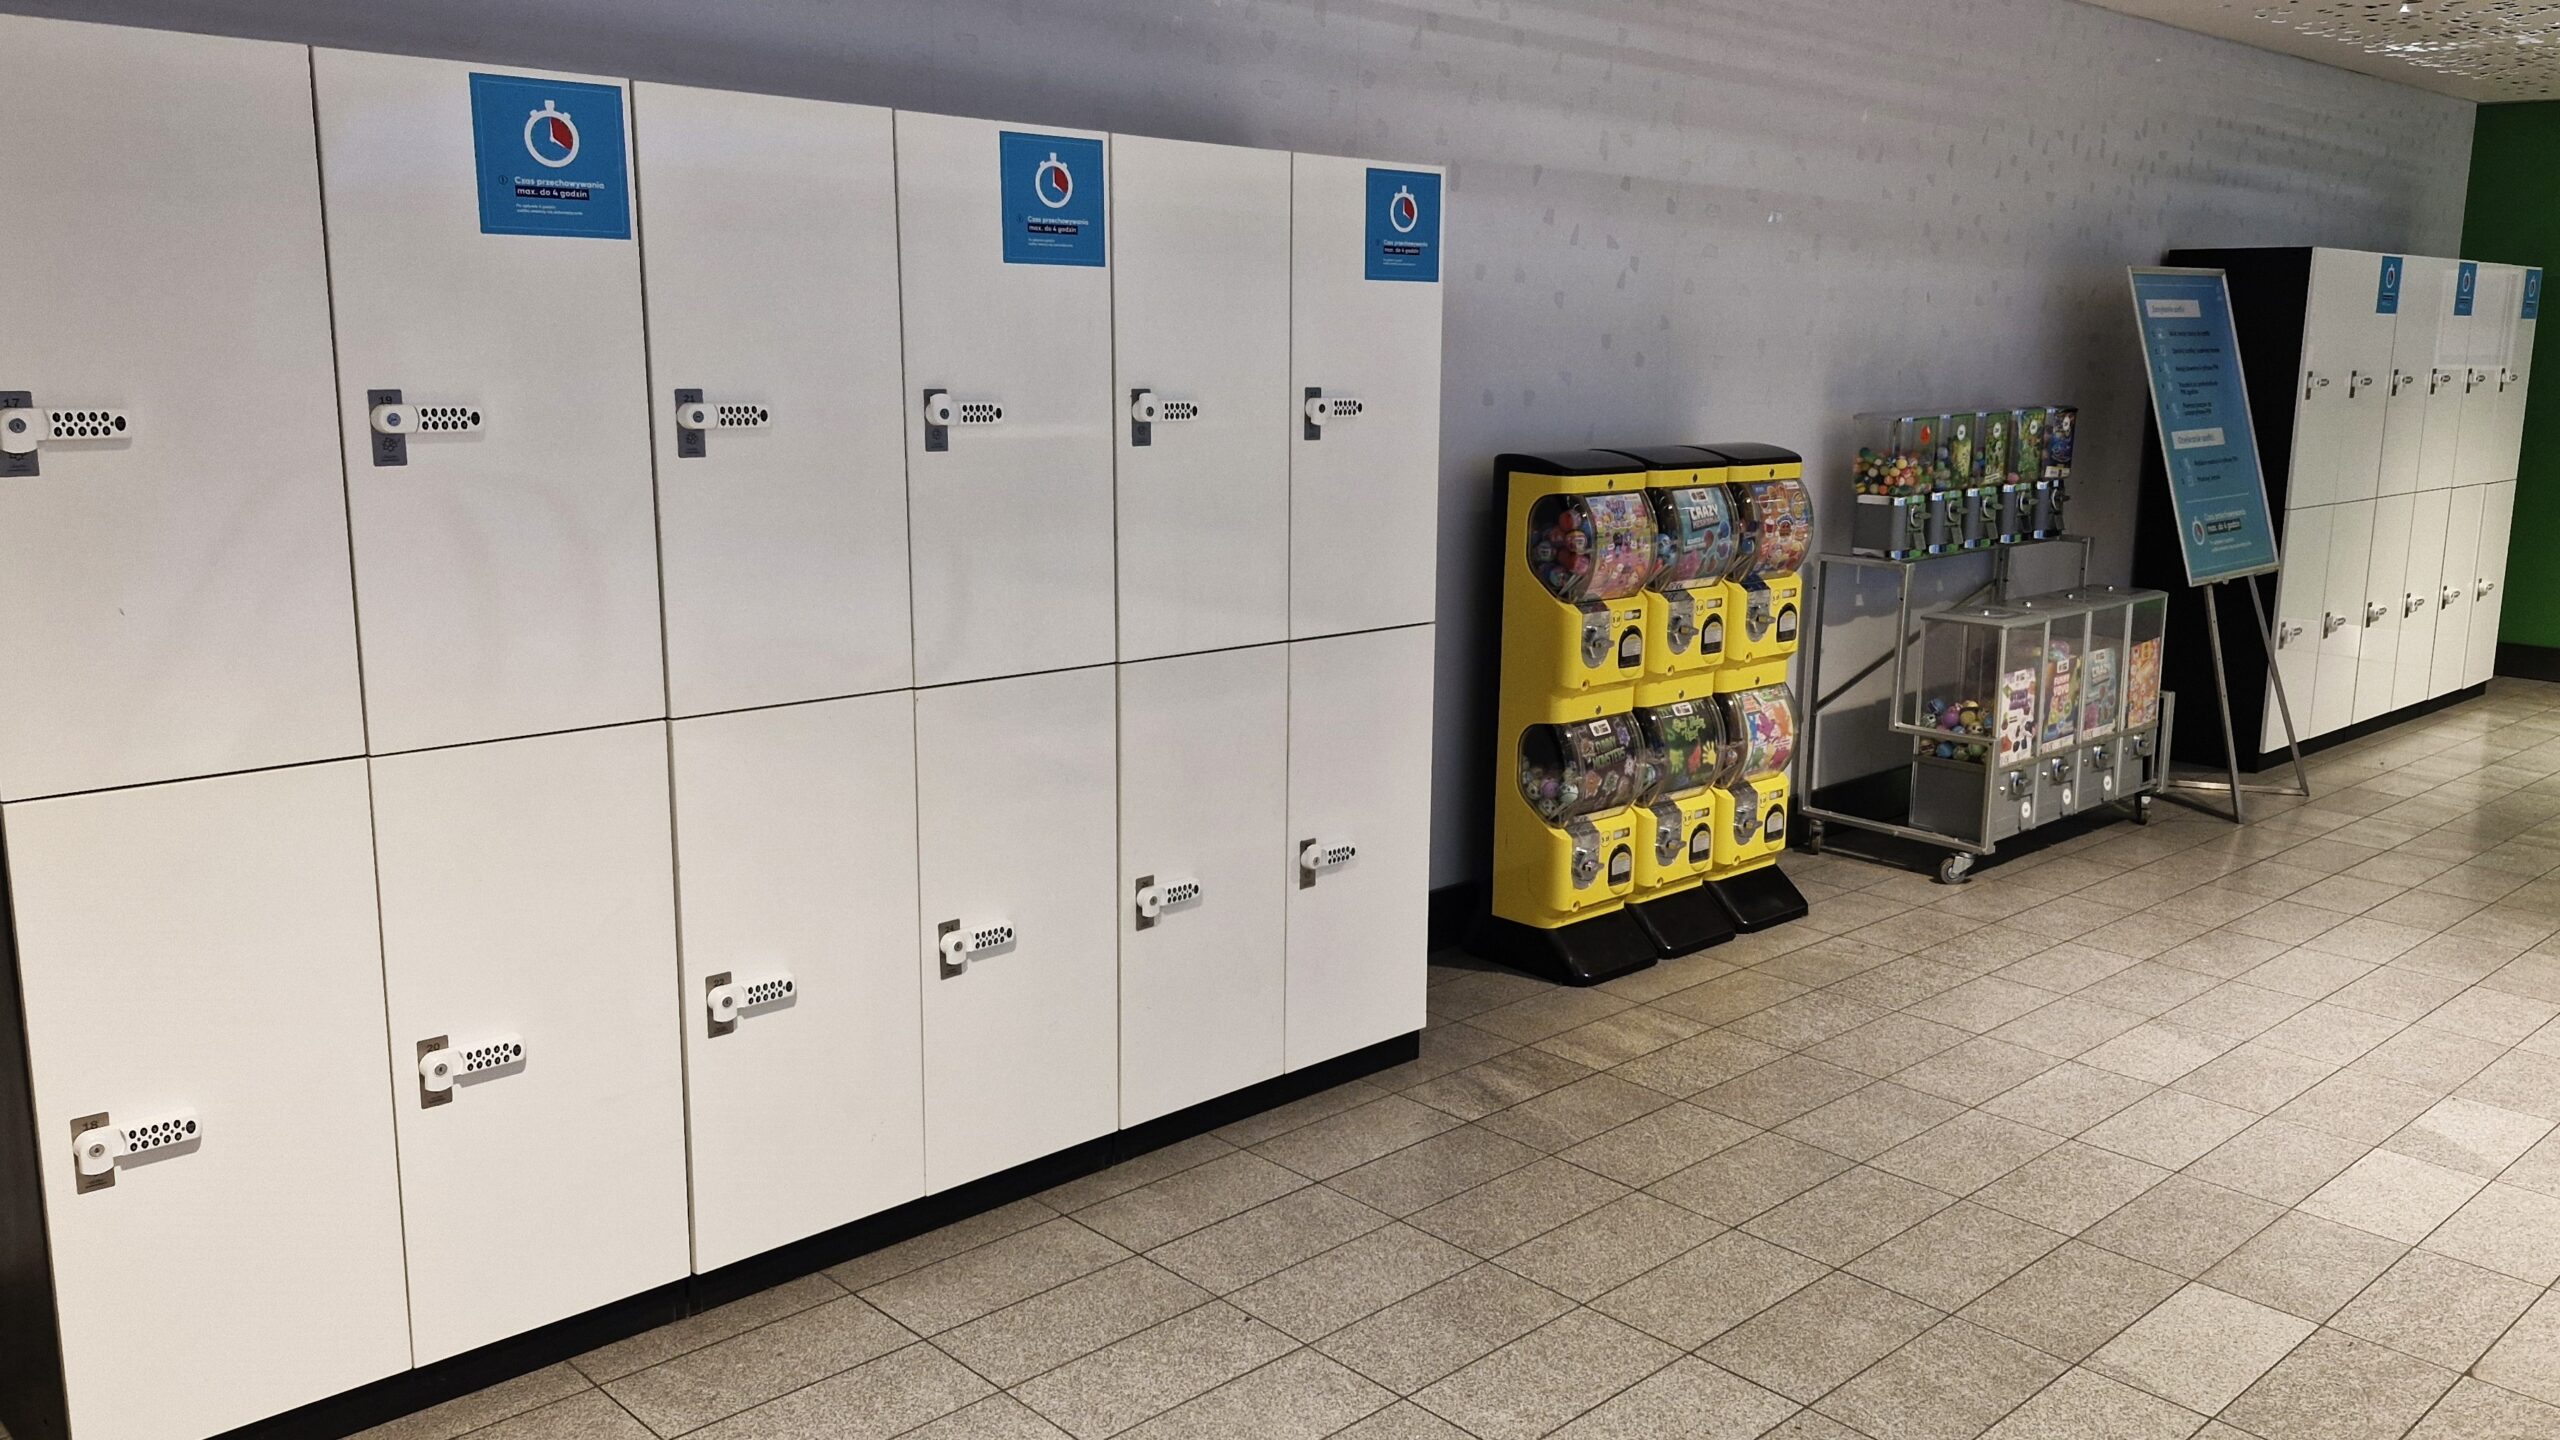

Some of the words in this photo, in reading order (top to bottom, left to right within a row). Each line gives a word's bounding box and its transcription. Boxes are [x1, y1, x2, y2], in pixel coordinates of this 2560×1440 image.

[514, 176, 535, 185] Czas
[536, 179, 605, 189] przechowywania
[559, 190, 588, 198] godzin
[3, 398, 20, 408] 17
[379, 395, 393, 405] 19
[1689, 503, 1719, 521] CRAZY
[427, 1042, 440, 1053] 20
[82, 1120, 99, 1131] 18
